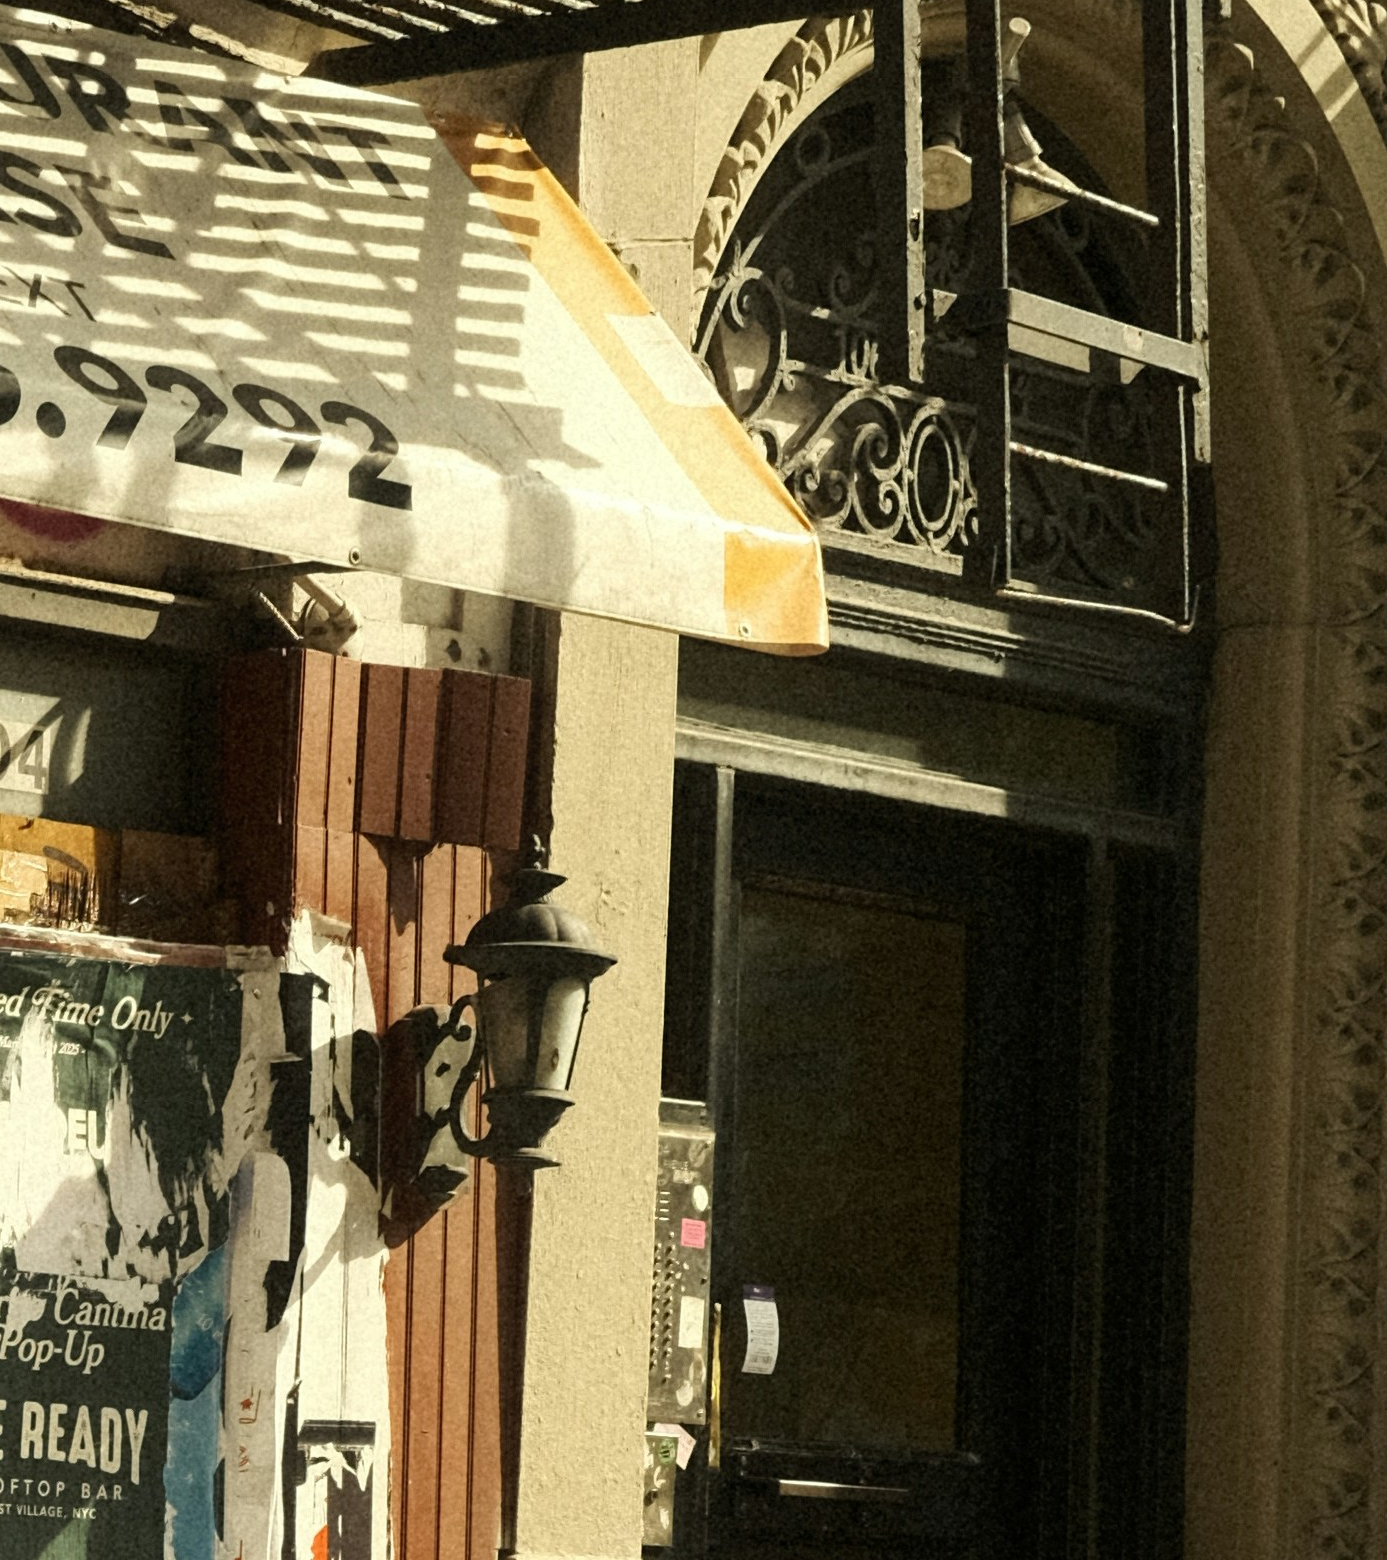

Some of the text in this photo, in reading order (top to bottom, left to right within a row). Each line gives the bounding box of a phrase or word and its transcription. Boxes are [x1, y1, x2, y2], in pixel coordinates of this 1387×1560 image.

[31, 985, 104, 1028] Time
[113, 995, 174, 1039] Only
[21, 1401, 148, 1485] READY
[82, 1483, 123, 1500] BAR
[72, 1507, 97, 1520] NYC
